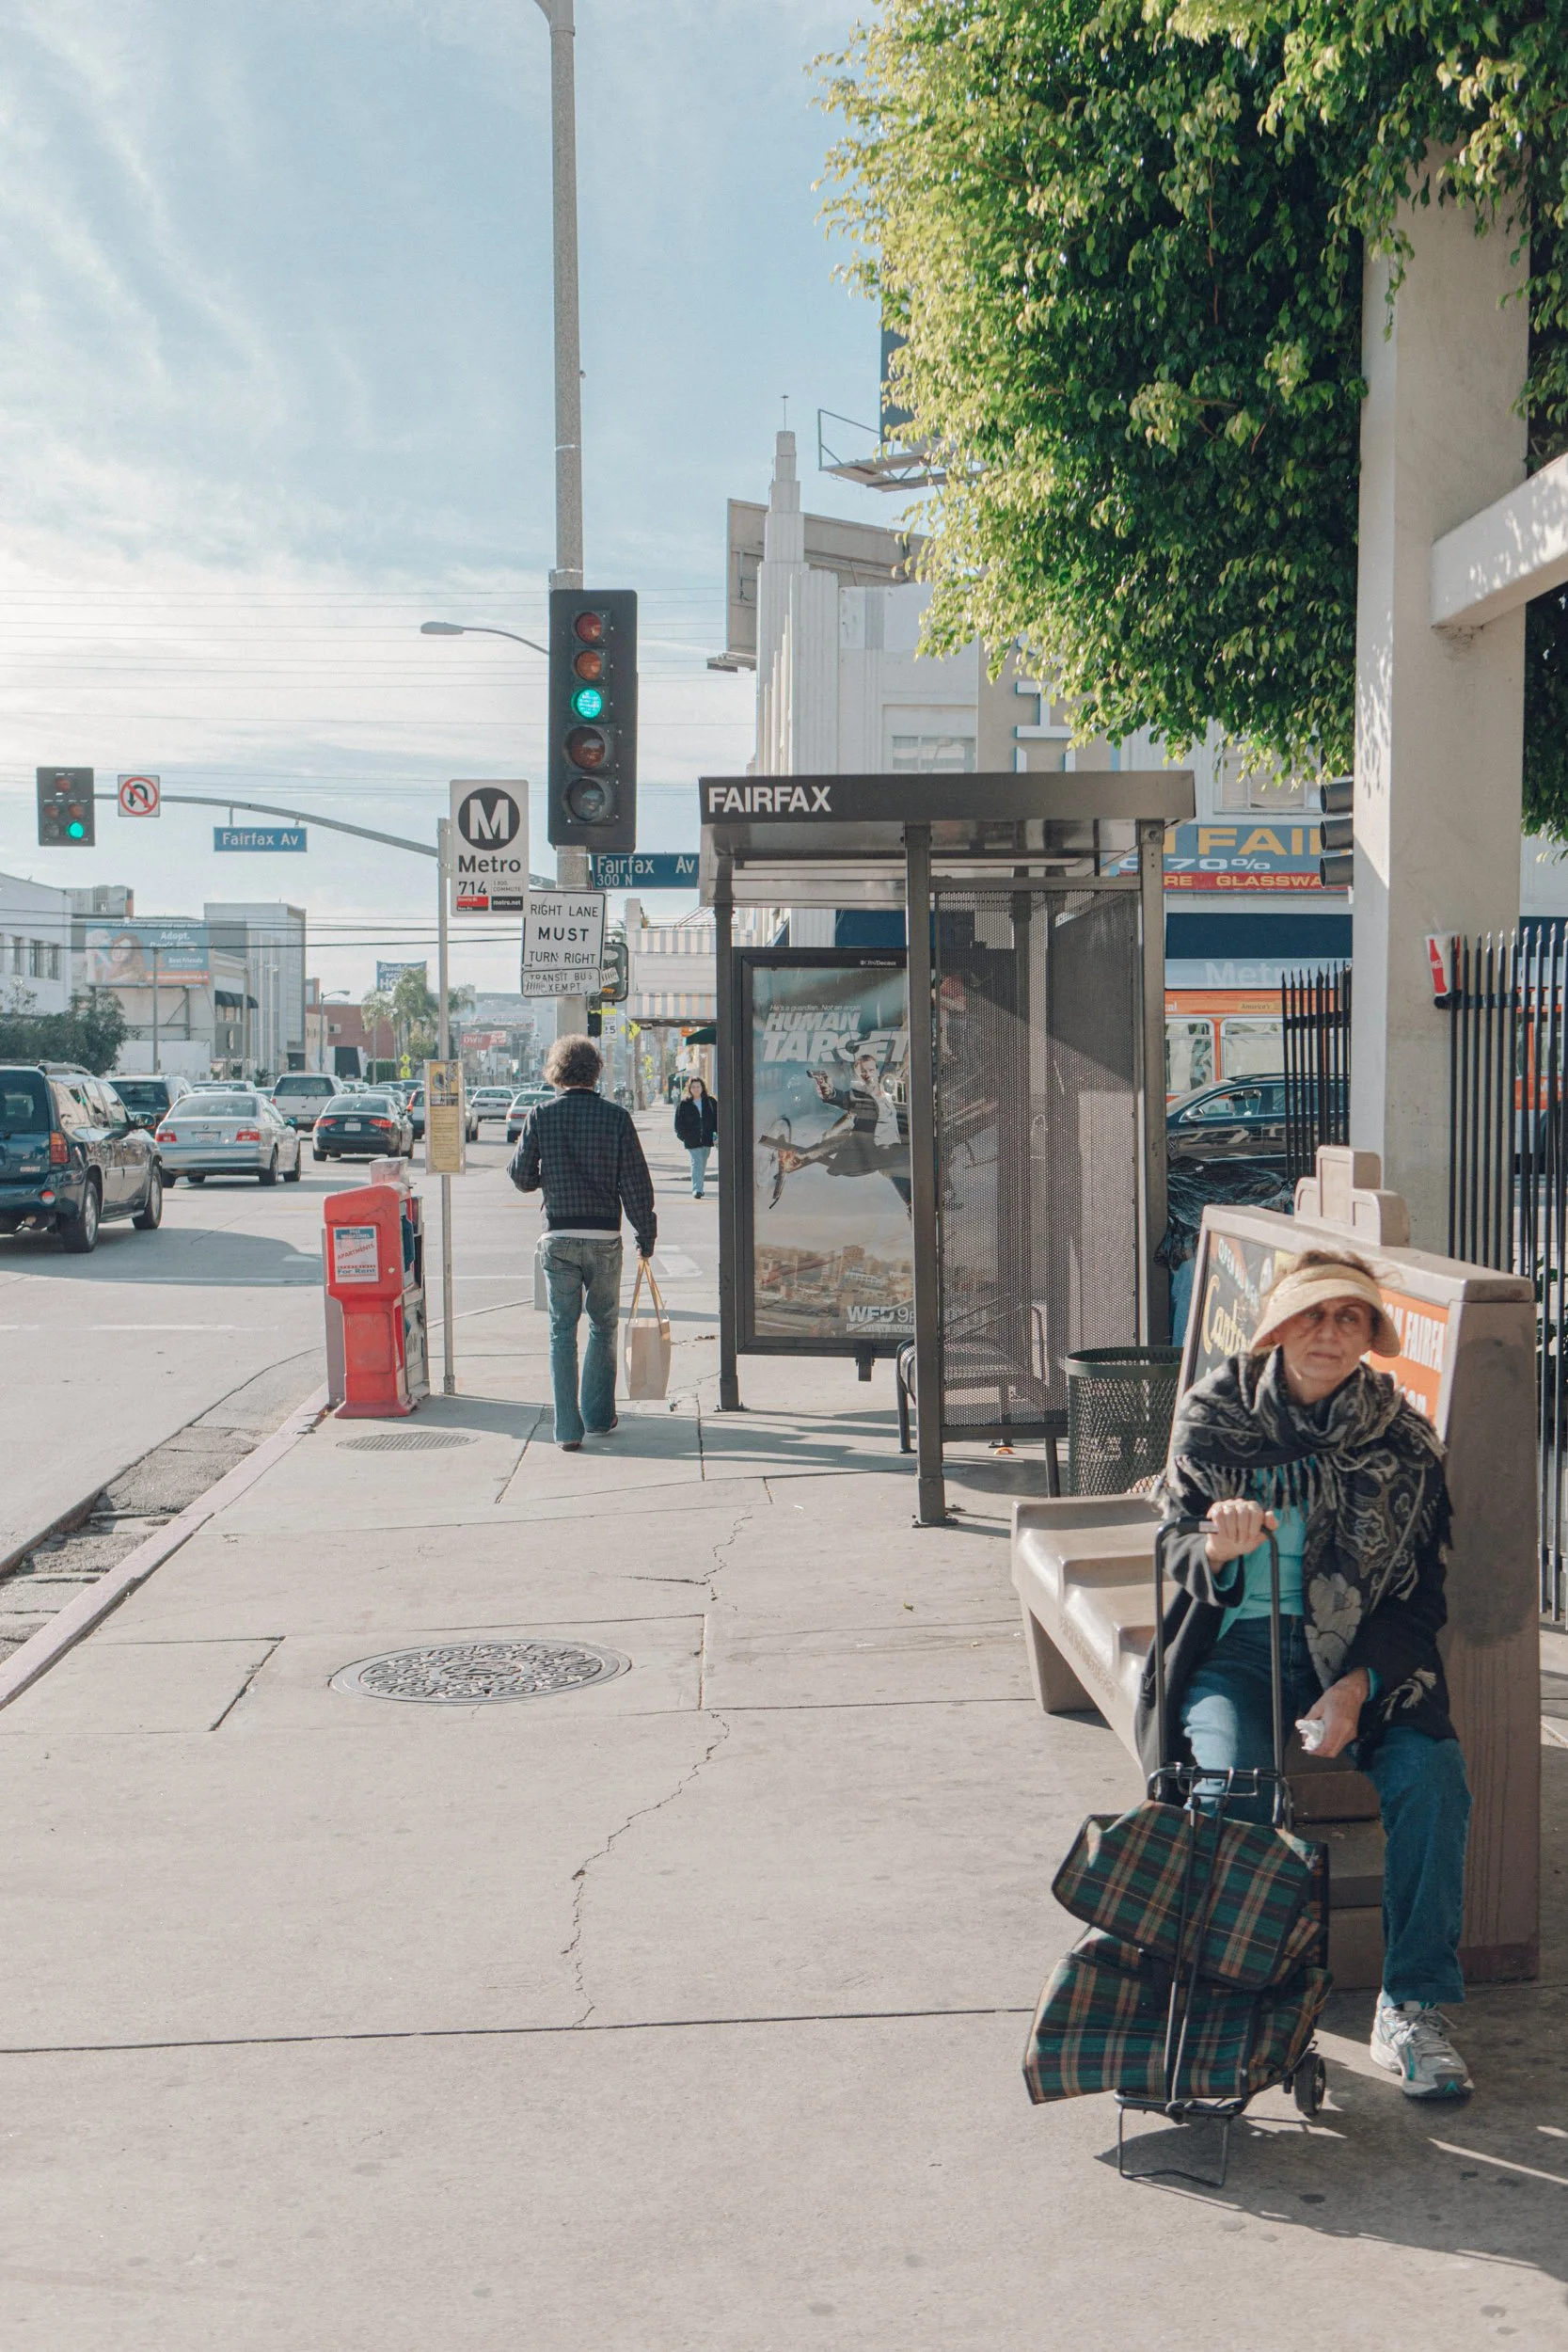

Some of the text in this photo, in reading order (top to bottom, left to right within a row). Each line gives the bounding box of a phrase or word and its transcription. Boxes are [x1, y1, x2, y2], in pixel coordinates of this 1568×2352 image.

[707, 786, 832, 814] FAIRFAX
[469, 799, 510, 840] M
[222, 832, 299, 846] Fairfax Av
[1197, 828, 1322, 856] FAI
[458, 854, 522, 873] Metro
[596, 855, 695, 874] Fairfax Av
[1167, 857, 1271, 870] 70%
[596, 873, 633, 886] 300 N
[458, 881, 488, 896] 714
[530, 904, 600, 918] RIGHT LANE
[160, 931, 191, 941] Adopt.
[537, 926, 590, 942] MUST
[529, 951, 596, 964] TURN RIGHT
[530, 973, 568, 982] TRANSIT
[574, 972, 593, 981] BUS
[546, 982, 582, 993] XEMPT
[765, 1011, 862, 1031] HUMAN
[762, 1030, 910, 1062] TARGET
[847, 1306, 895, 1323] WED
